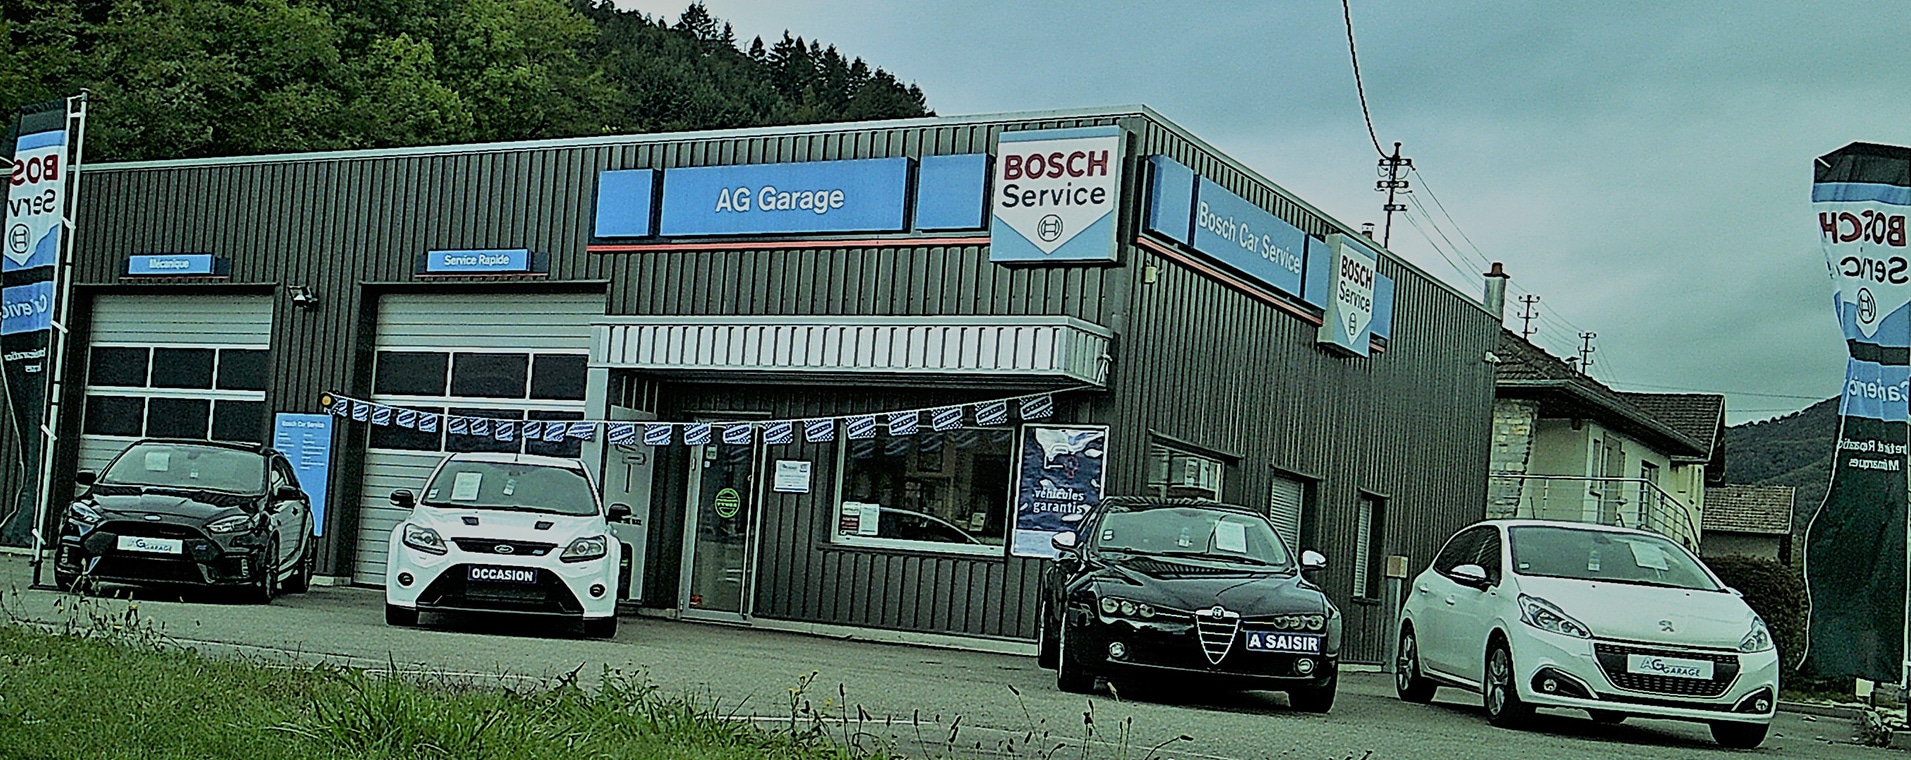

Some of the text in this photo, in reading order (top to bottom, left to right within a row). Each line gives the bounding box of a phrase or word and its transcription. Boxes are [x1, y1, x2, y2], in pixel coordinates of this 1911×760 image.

[1004, 150, 1109, 180] BOSCH
[715, 185, 845, 214] AG Garage
[1001, 182, 1106, 208] Service
[1199, 201, 1301, 275] Bosch Car Service
[444, 254, 510, 267] Service Rapide
[1341, 255, 1373, 291] BOSCH
[1339, 280, 1371, 313] Service
[1034, 487, 1085, 501] véhicules
[1033, 502, 1084, 514] garantis
[472, 568, 534, 582] OCCASION
[1249, 633, 1318, 652] A SAISIR
[1663, 666, 1700, 677] GARAGE
